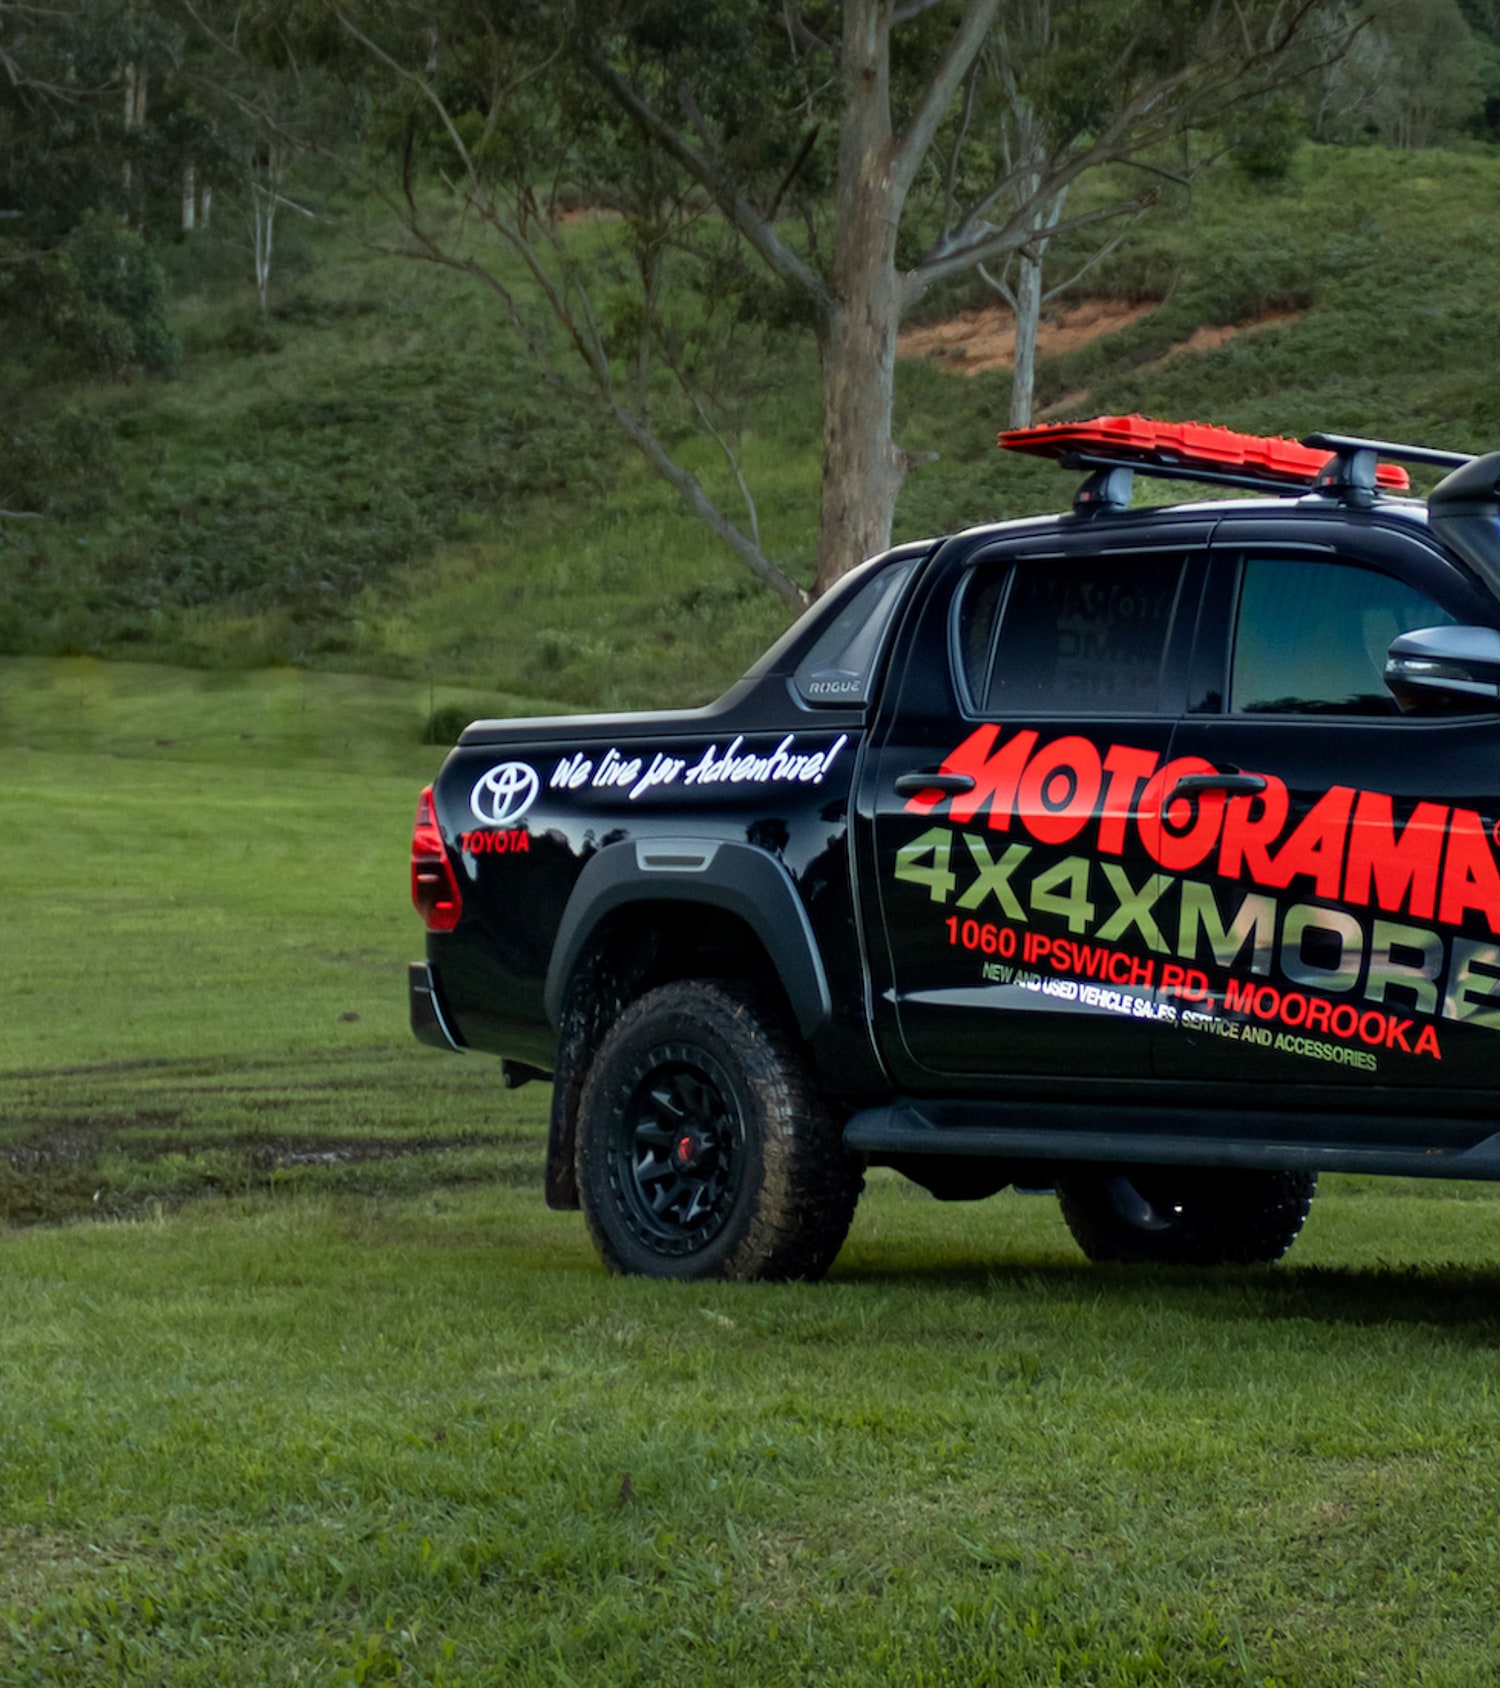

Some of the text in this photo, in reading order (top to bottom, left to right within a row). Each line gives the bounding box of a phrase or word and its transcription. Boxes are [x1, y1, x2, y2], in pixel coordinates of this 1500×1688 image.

[809, 680, 861, 694] ROGUE
[549, 734, 848, 800] We live for Adventure!
[460, 829, 530, 854] TOYOTA
[946, 916, 1442, 1060] 1060 IPSWICH RD, MOOROOKA
[982, 961, 1014, 984] NEW
[1013, 969, 1043, 991] AND
[1041, 976, 1079, 1000] USED
[1079, 983, 1133, 1015] VEHICLE
[1181, 1009, 1240, 1040] SERVICE
[1241, 1025, 1274, 1047] AND
[1274, 1032, 1378, 1072] ACCESSORIES
